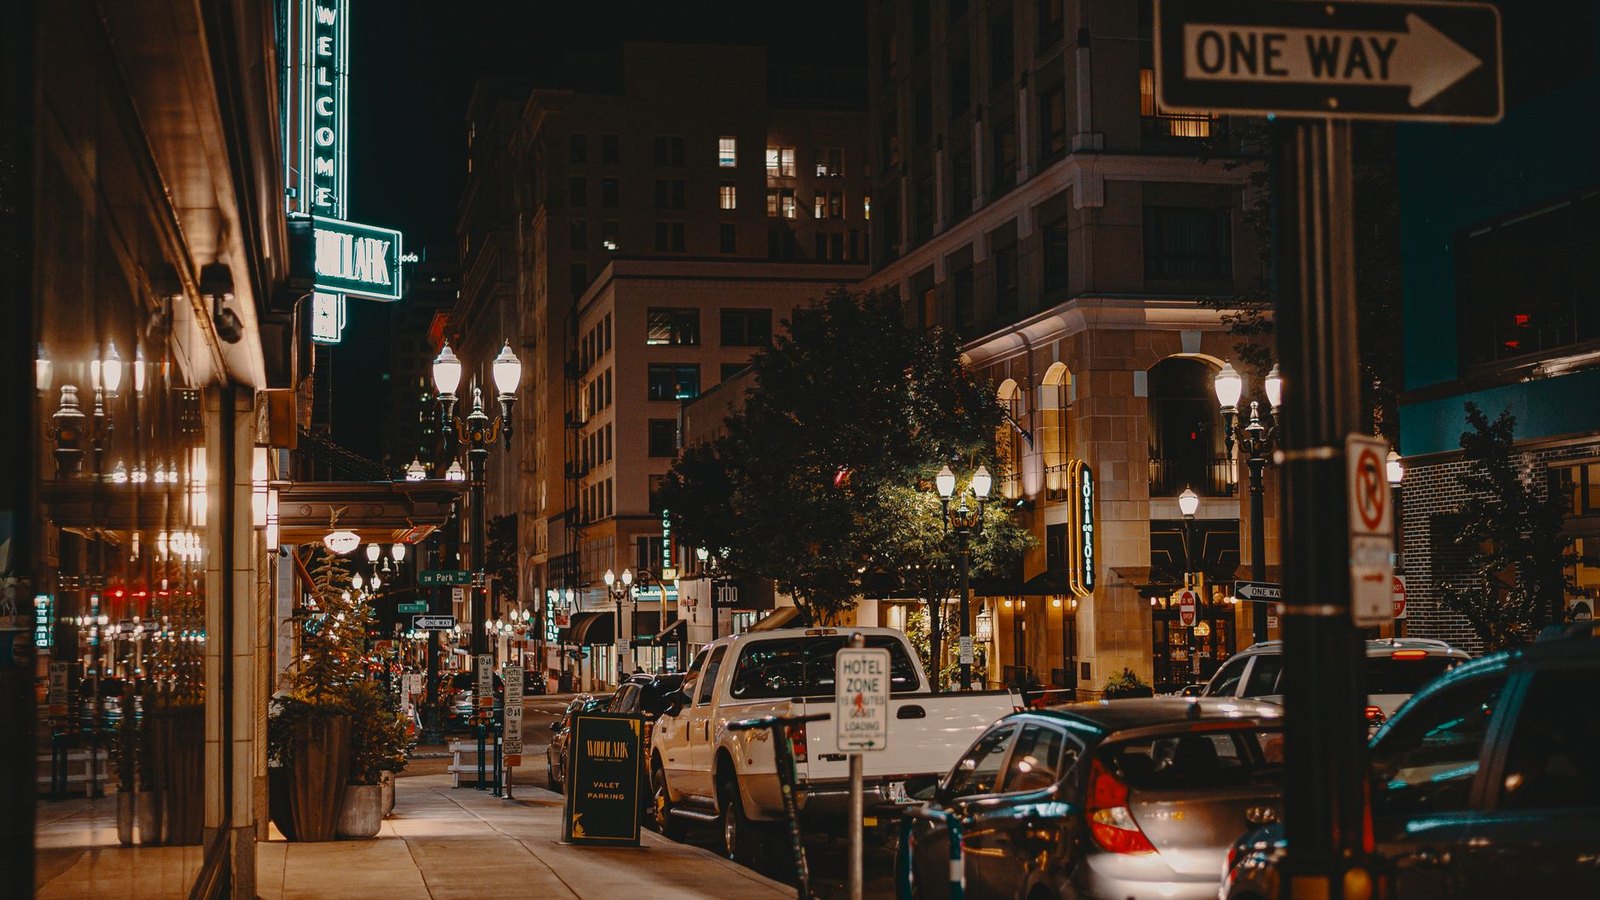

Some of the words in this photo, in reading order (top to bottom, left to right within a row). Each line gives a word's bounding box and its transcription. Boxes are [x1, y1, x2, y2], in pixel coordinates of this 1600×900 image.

[1197, 30, 1289, 77] ONE
[1306, 34, 1398, 80] WAY
[315, 5, 337, 206] WELCOME
[662, 509, 671, 567] COFFEE
[436, 573, 453, 582] Park
[1251, 587, 1266, 596] ONE
[843, 660, 883, 675] HOTEL
[846, 678, 879, 693] ZONE
[851, 696, 885, 706] MUTES
[587, 792, 625, 801] PARKING
